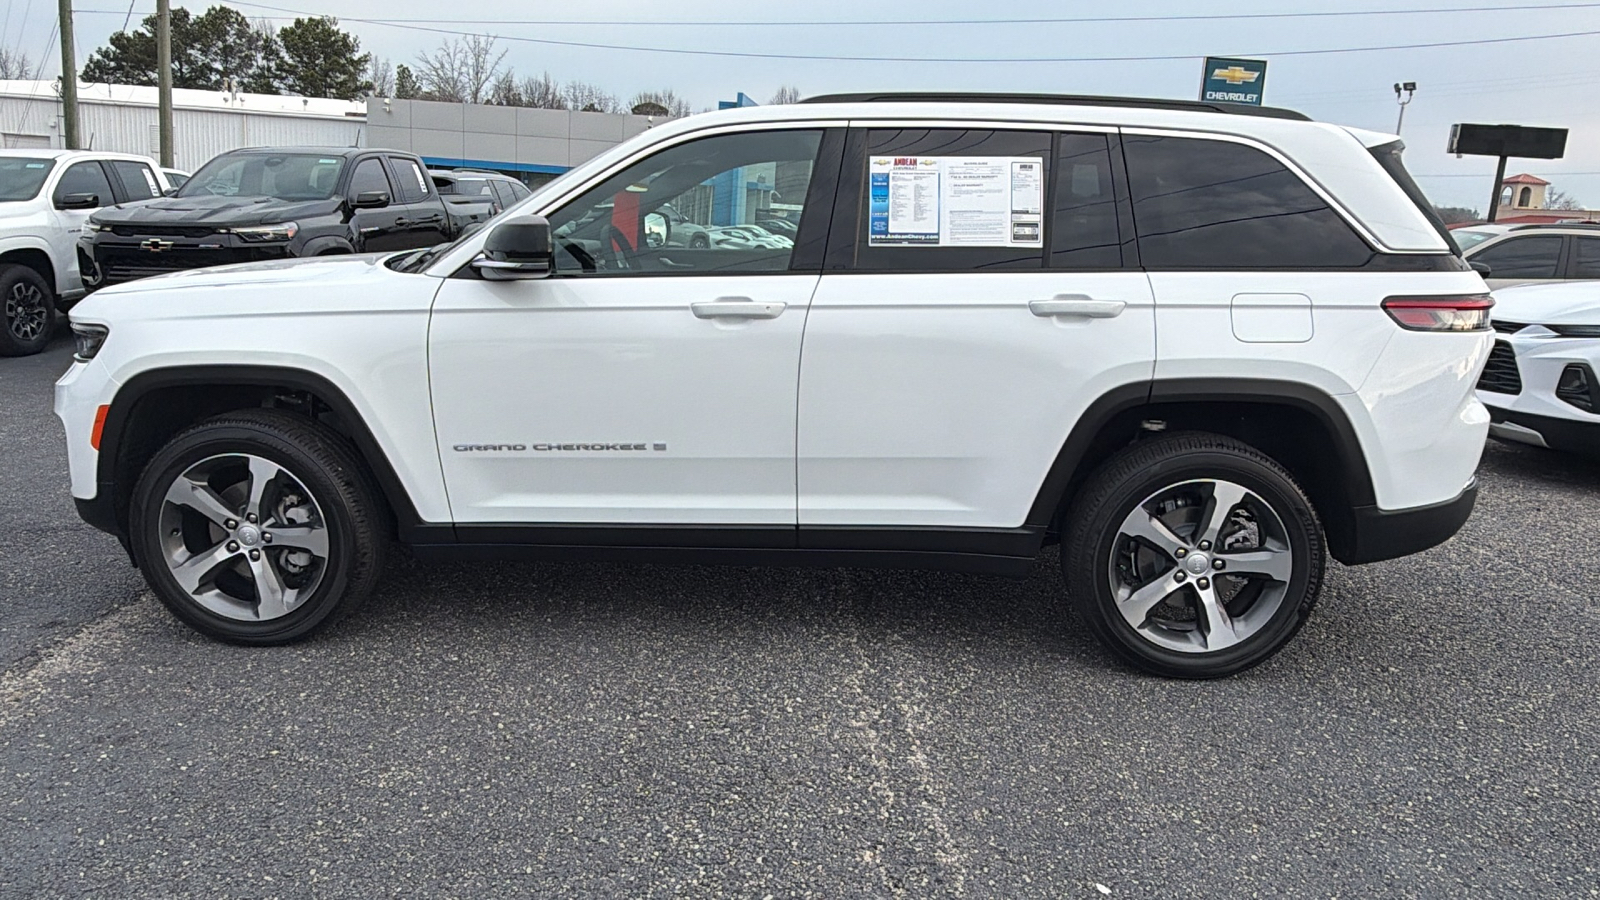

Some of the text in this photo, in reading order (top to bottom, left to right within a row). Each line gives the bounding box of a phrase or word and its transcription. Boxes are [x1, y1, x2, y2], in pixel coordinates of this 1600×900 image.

[1206, 91, 1259, 102] CHEVROLET
[893, 158, 917, 166] ANDEAN
[452, 443, 647, 452] GRAND CHEROKEE
